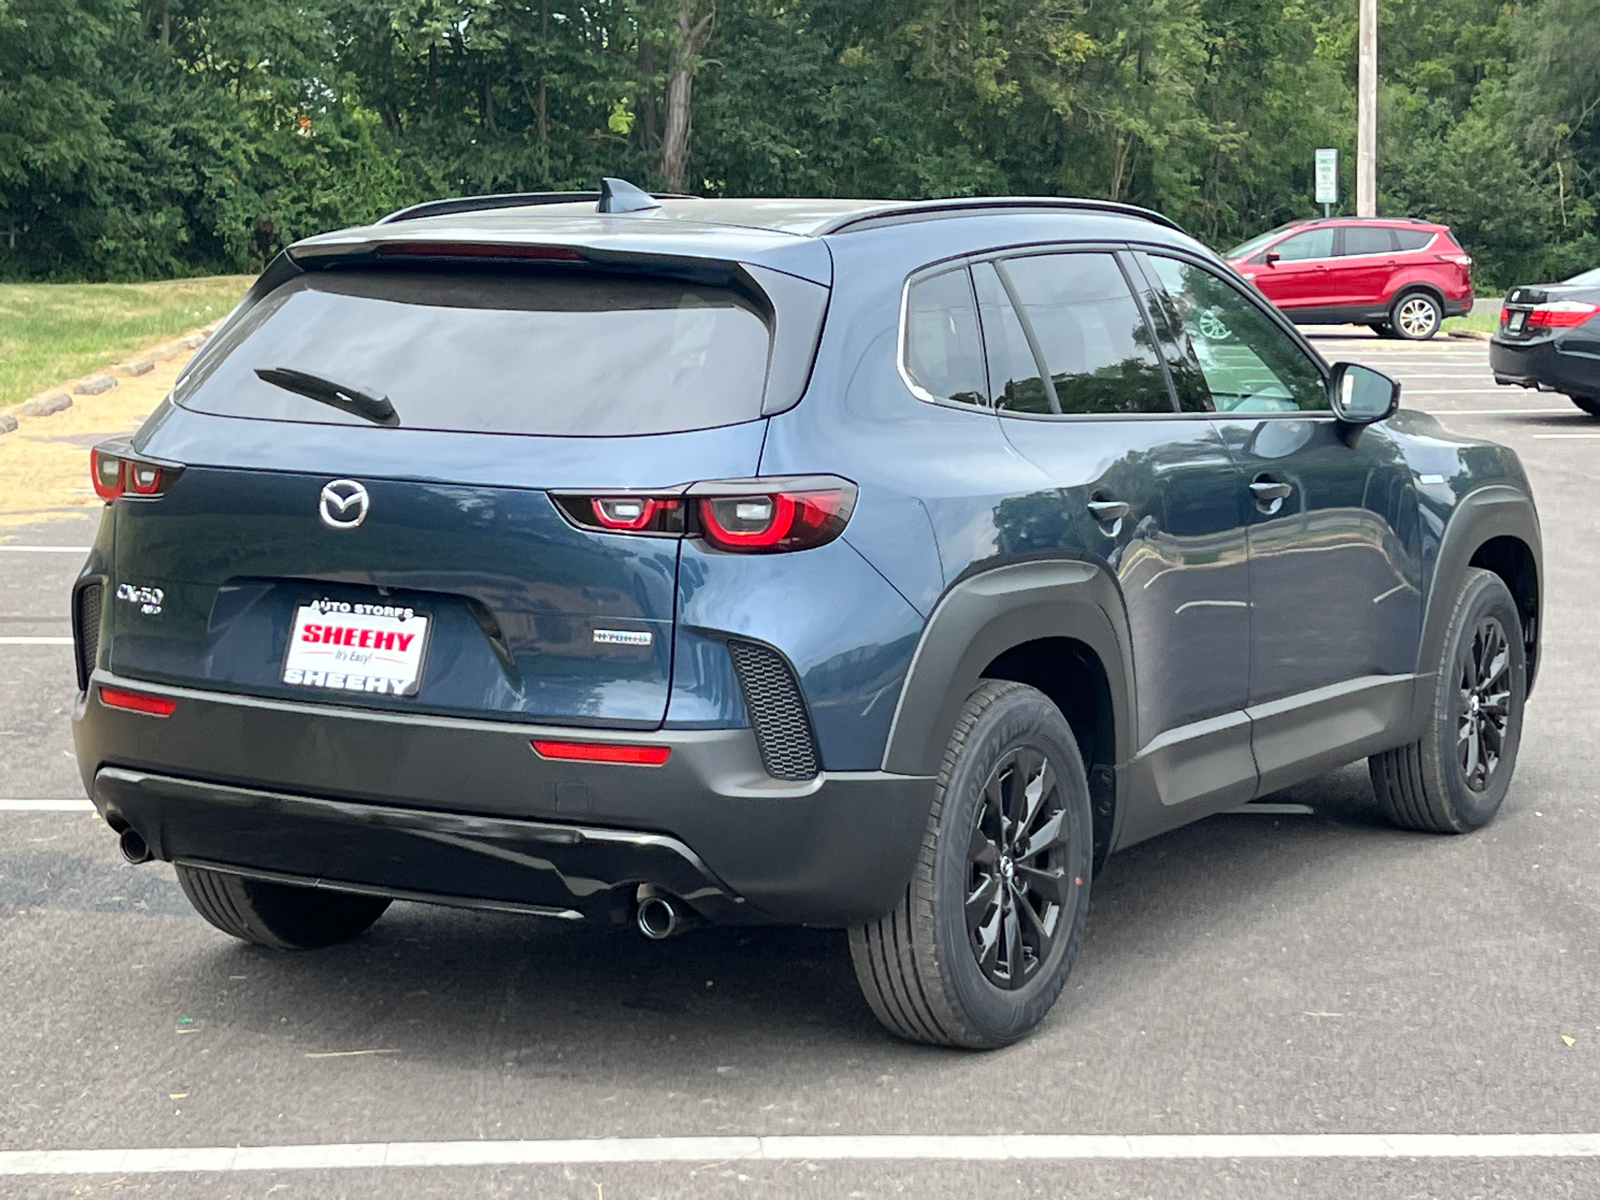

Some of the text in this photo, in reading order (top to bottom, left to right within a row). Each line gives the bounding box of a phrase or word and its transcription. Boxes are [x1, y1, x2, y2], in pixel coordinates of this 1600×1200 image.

[310, 600, 351, 613] AUTO
[301, 623, 416, 652] SHEEHY
[334, 649, 374, 665] It's Easy!
[283, 668, 412, 695] SHEEHY
